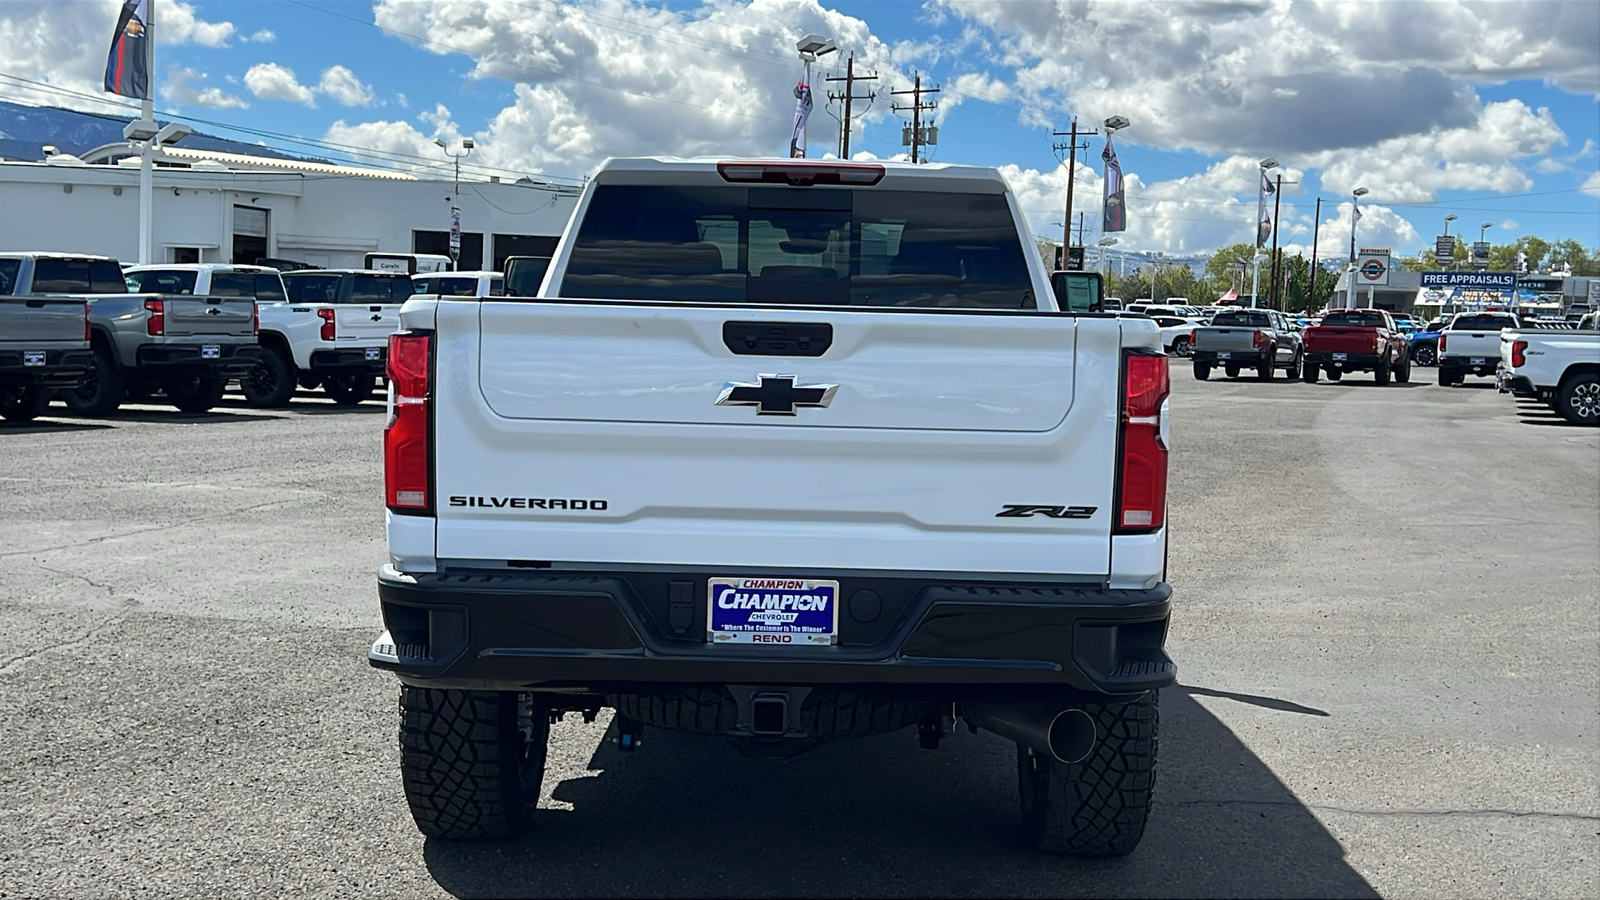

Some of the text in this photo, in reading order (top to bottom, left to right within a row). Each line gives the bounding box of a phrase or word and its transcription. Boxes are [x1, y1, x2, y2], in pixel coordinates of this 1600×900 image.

[1424, 274, 1514, 285] FREE APPRAISALS!
[449, 495, 608, 511] SILVERADO
[995, 504, 1098, 519] ZR2
[743, 579, 804, 589] CHAMPION
[718, 588, 828, 611] CHAMPION
[751, 613, 795, 621] CHEVROLET
[755, 624, 783, 632] Customer
[752, 634, 792, 643] RENO
